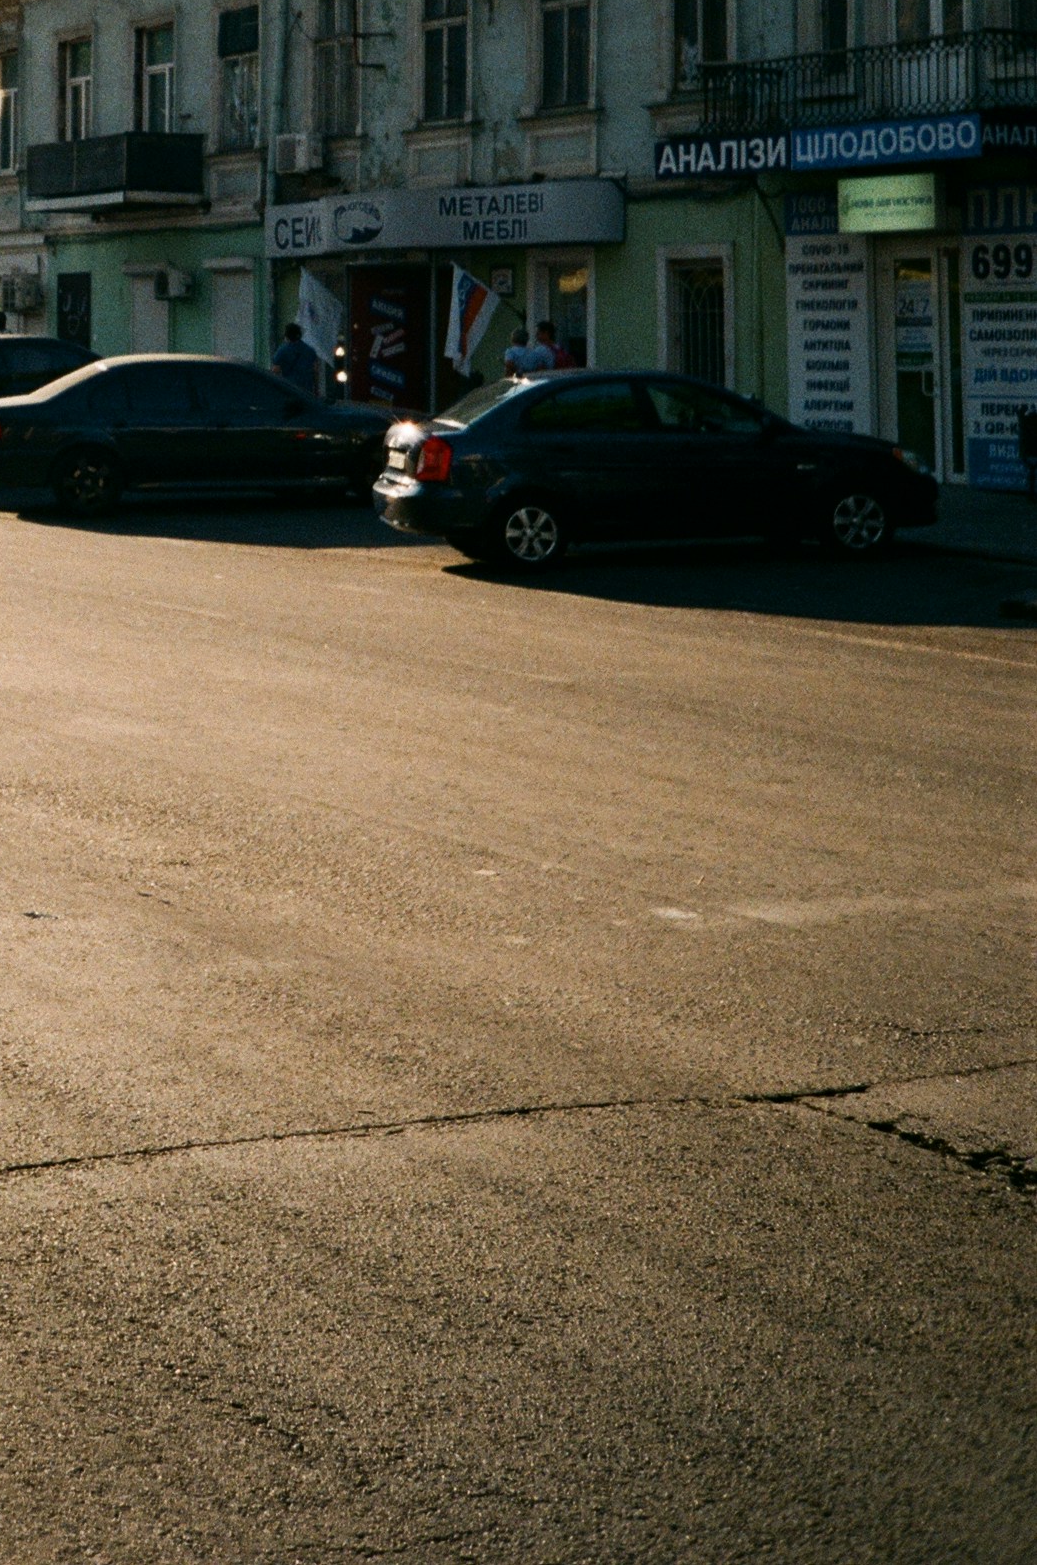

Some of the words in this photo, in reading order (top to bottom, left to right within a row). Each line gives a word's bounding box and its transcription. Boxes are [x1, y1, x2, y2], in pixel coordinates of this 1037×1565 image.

[795, 120, 978, 163] ЦІЛОДОБОВО
[658, 136, 787, 174] АНАЛІЗИ
[439, 193, 544, 217] МЕТАЛЕВІ
[463, 219, 527, 240] МЕБЛІ
[972, 243, 1033, 280] 699
[803, 319, 850, 332] ГОРМОНИ
[803, 339, 851, 352] АНТИТІЛА
